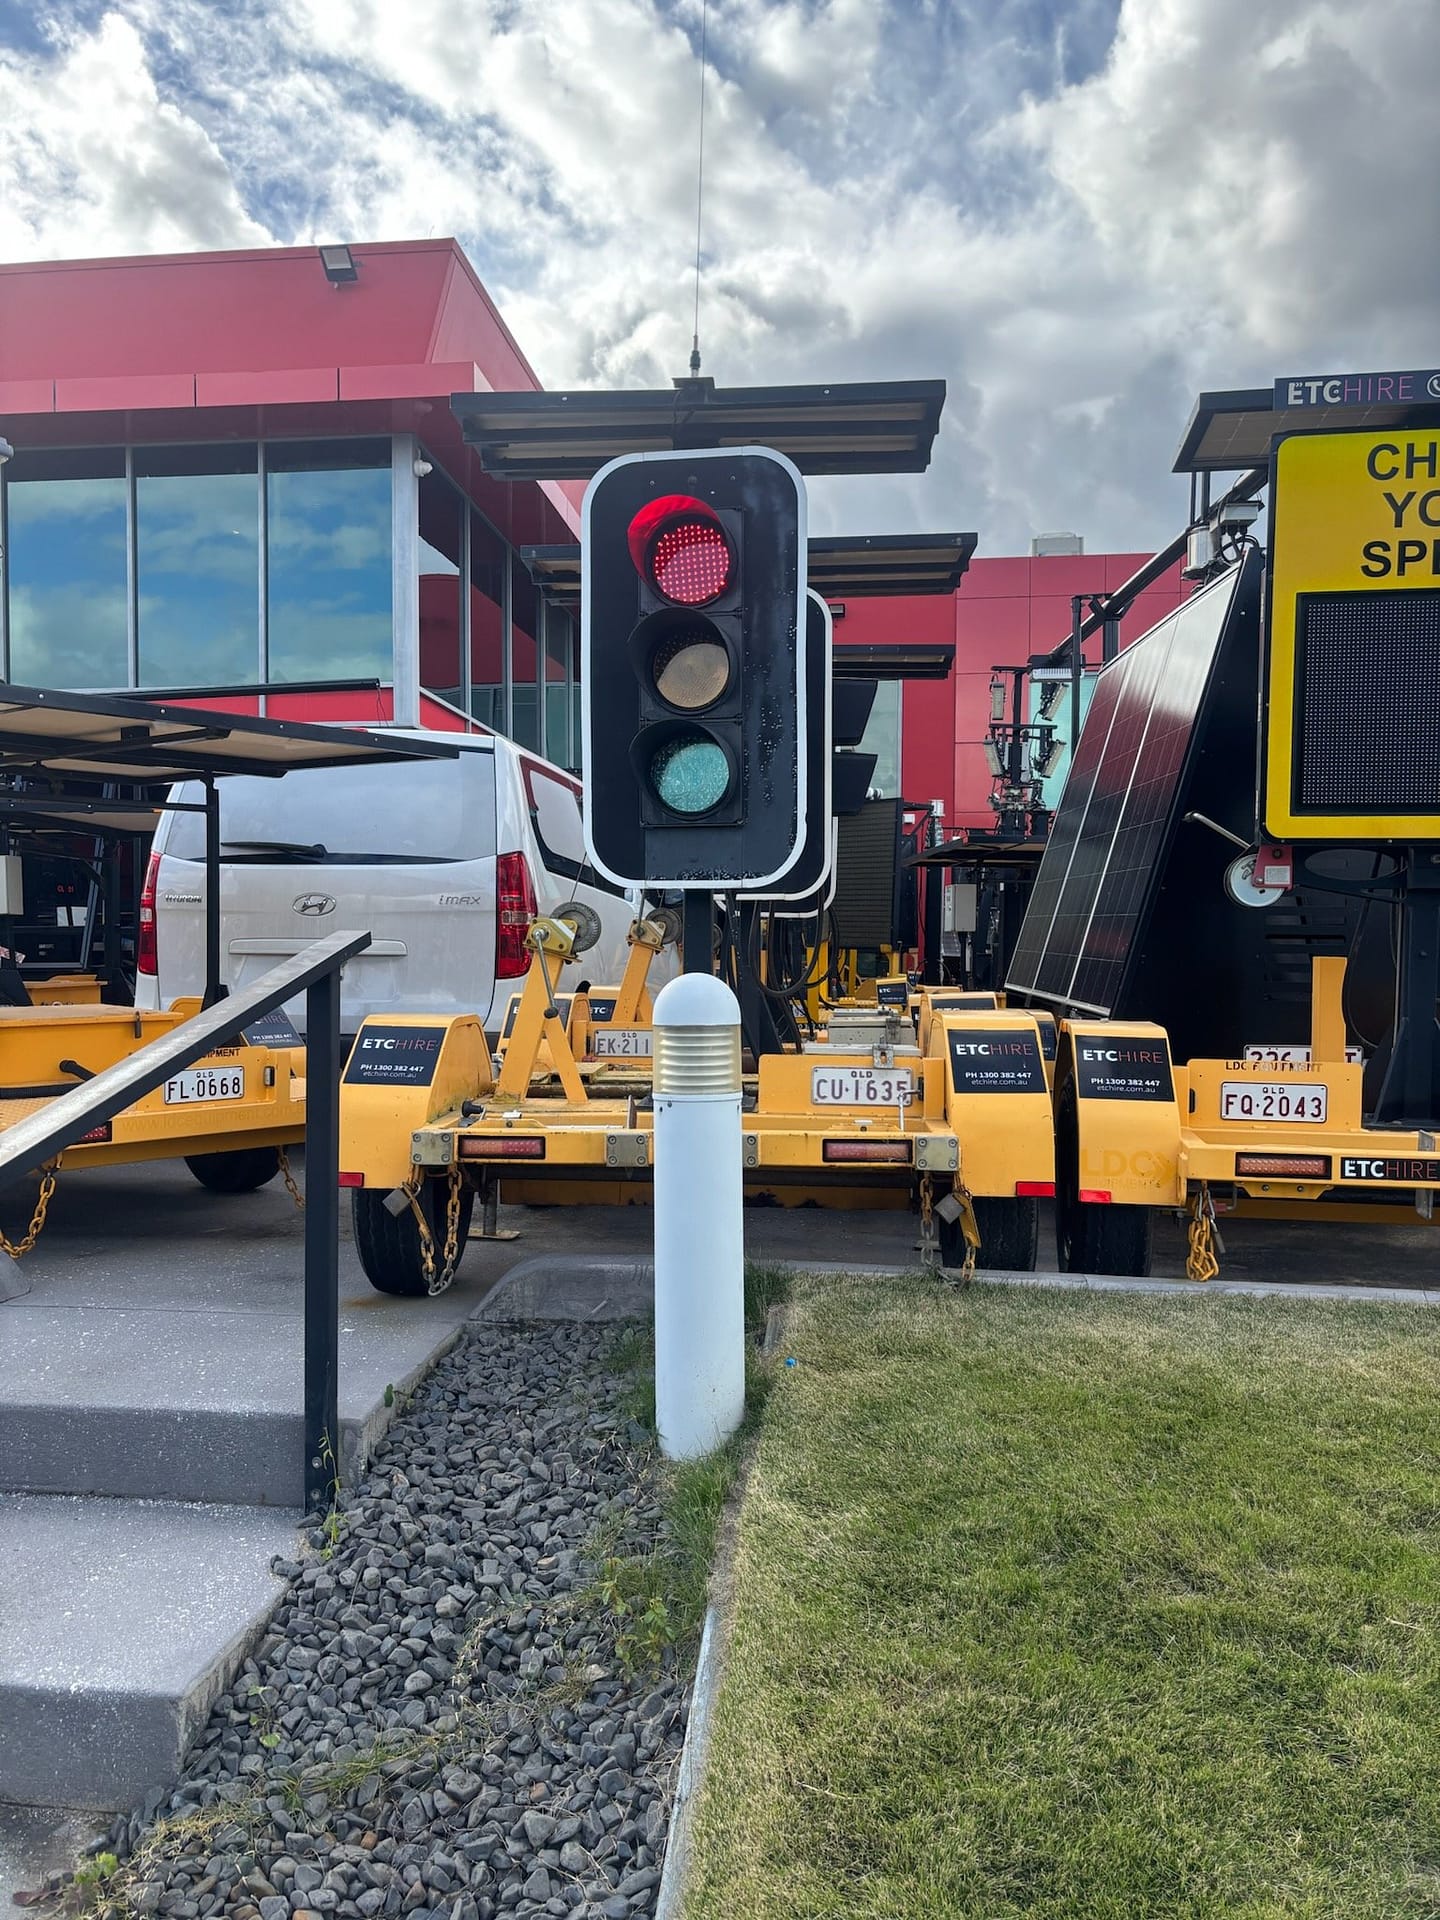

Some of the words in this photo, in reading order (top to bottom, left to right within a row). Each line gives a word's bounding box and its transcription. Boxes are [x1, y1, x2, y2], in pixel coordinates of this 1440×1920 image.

[1288, 375, 1414, 405] ETCHIRE
[362, 1038, 437, 1051] ETCHIRE
[956, 1043, 1034, 1056] ETCHIRE
[1082, 1049, 1165, 1064] ETCHIRE
[360, 1063, 373, 1071] PH
[409, 1065, 425, 1073] 447
[363, 1070, 418, 1079] etchire.com.au
[850, 1070, 873, 1078] QLD
[971, 1078, 1028, 1086] etchire.com.au
[1091, 1077, 1104, 1085] PH
[1097, 1084, 1156, 1093] etchire.com.au
[1262, 1086, 1285, 1094] QLD
[1344, 1159, 1439, 1179] ETCHIRE
